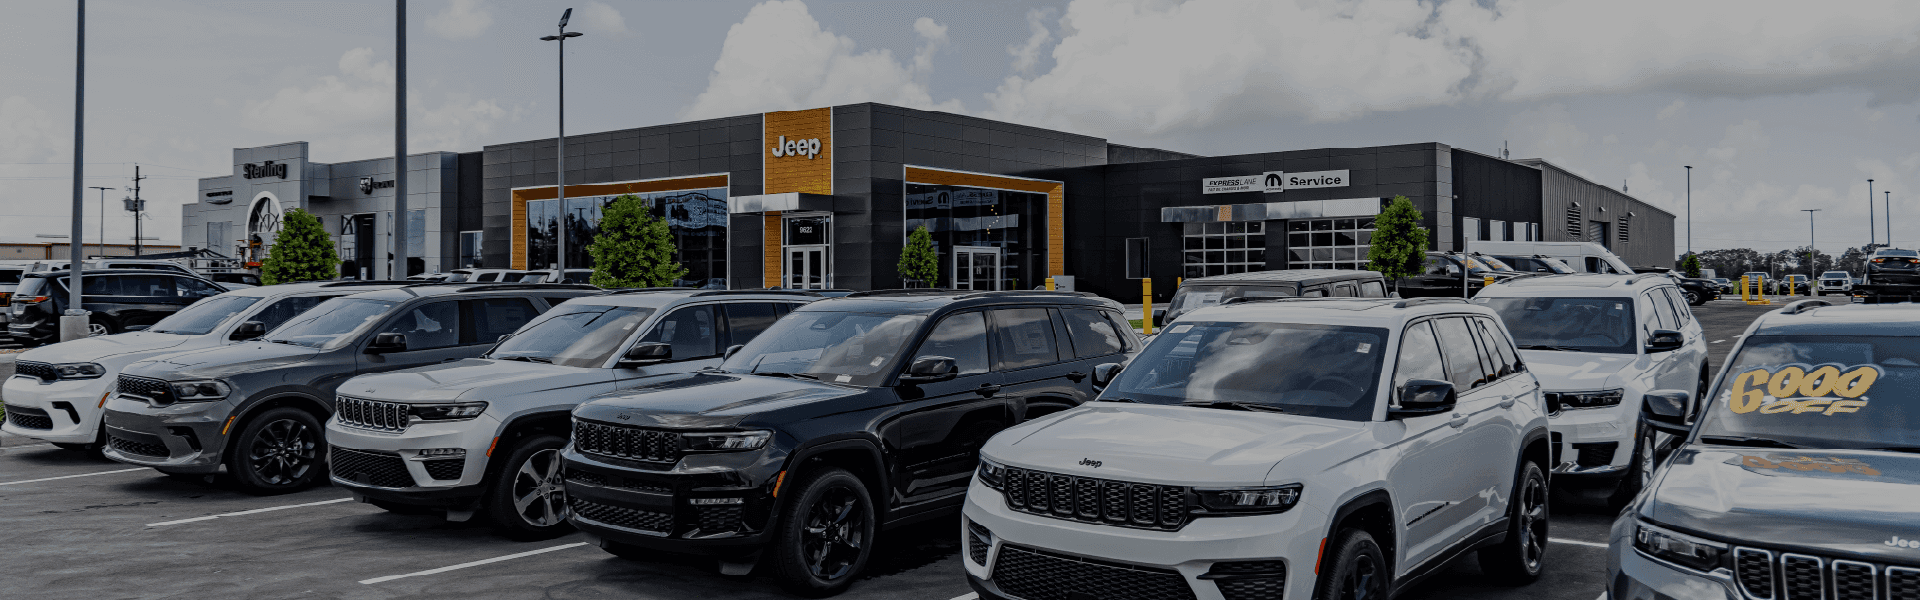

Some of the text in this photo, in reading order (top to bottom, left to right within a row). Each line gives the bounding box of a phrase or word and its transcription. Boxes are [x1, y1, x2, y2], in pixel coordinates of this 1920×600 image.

[772, 135, 821, 160] Jeep
[243, 160, 287, 180] Sterling
[1289, 175, 1342, 186] Service
[799, 226, 813, 234] 9622
[1759, 399, 1868, 417] OFF
[1079, 457, 1103, 469] Jeep
[1884, 535, 1920, 549] Jee
